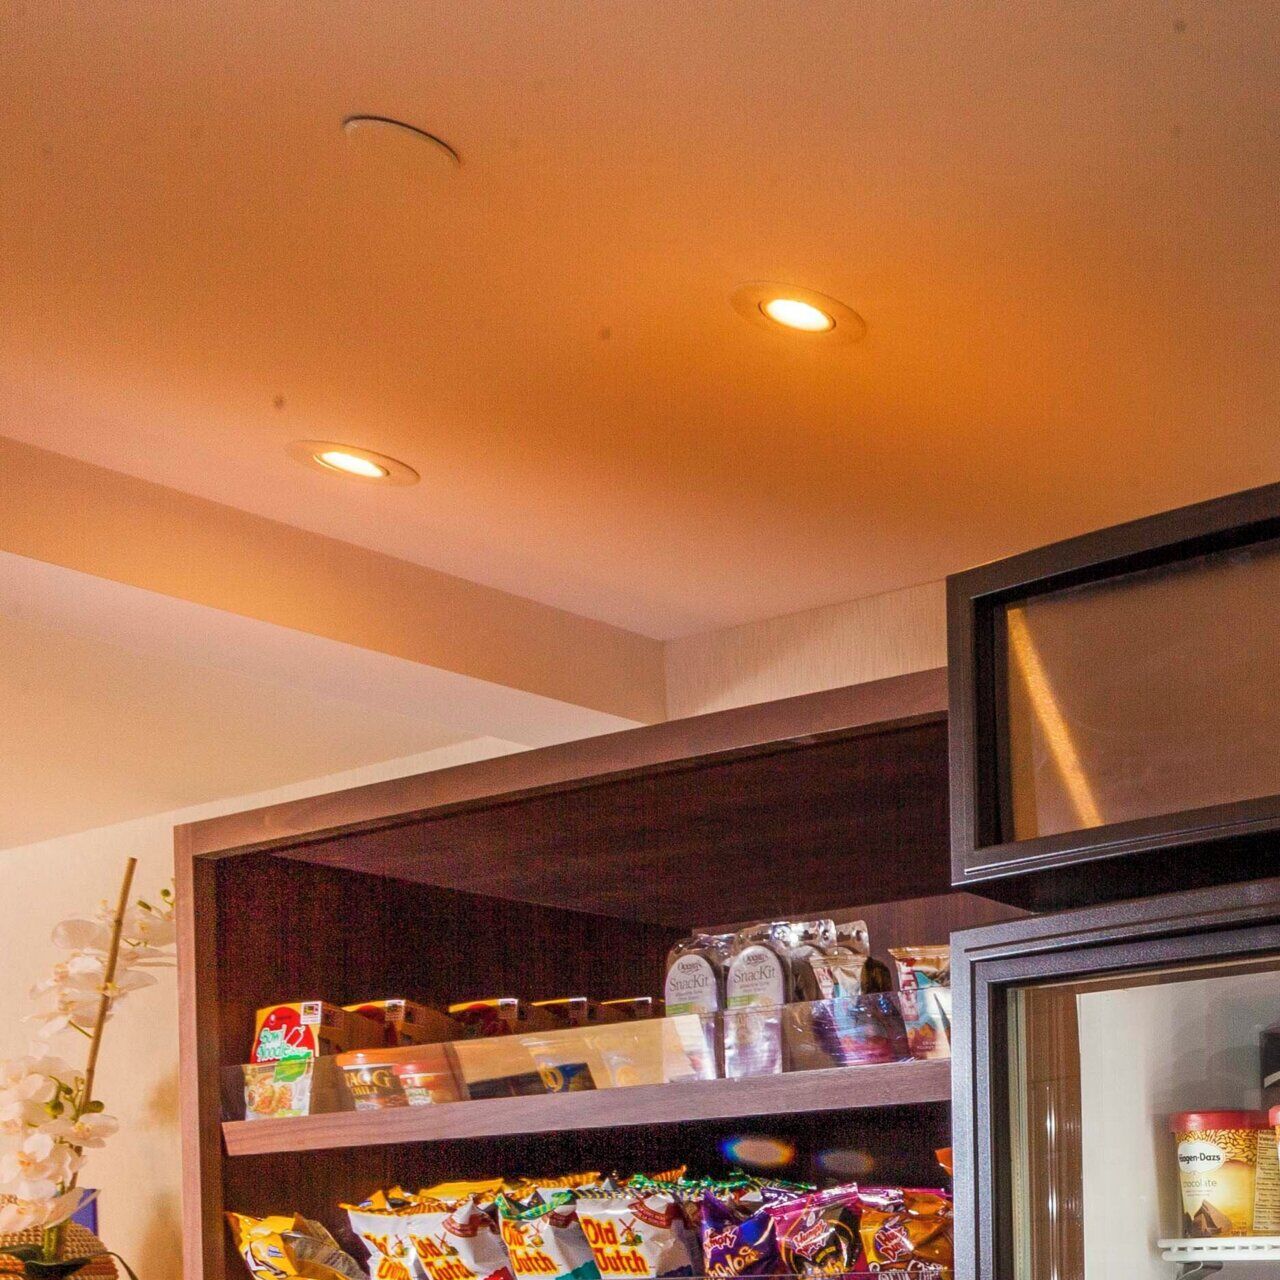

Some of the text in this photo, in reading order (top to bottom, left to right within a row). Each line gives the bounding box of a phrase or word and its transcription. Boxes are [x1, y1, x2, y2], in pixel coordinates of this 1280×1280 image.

[669, 974, 710, 992] SnacKit
[733, 967, 776, 984] SnacKit
[261, 1025, 286, 1045] Bowl
[582, 1218, 618, 1245] Old
[510, 1249, 560, 1274] Dutch
[593, 1248, 650, 1275] Dutch
